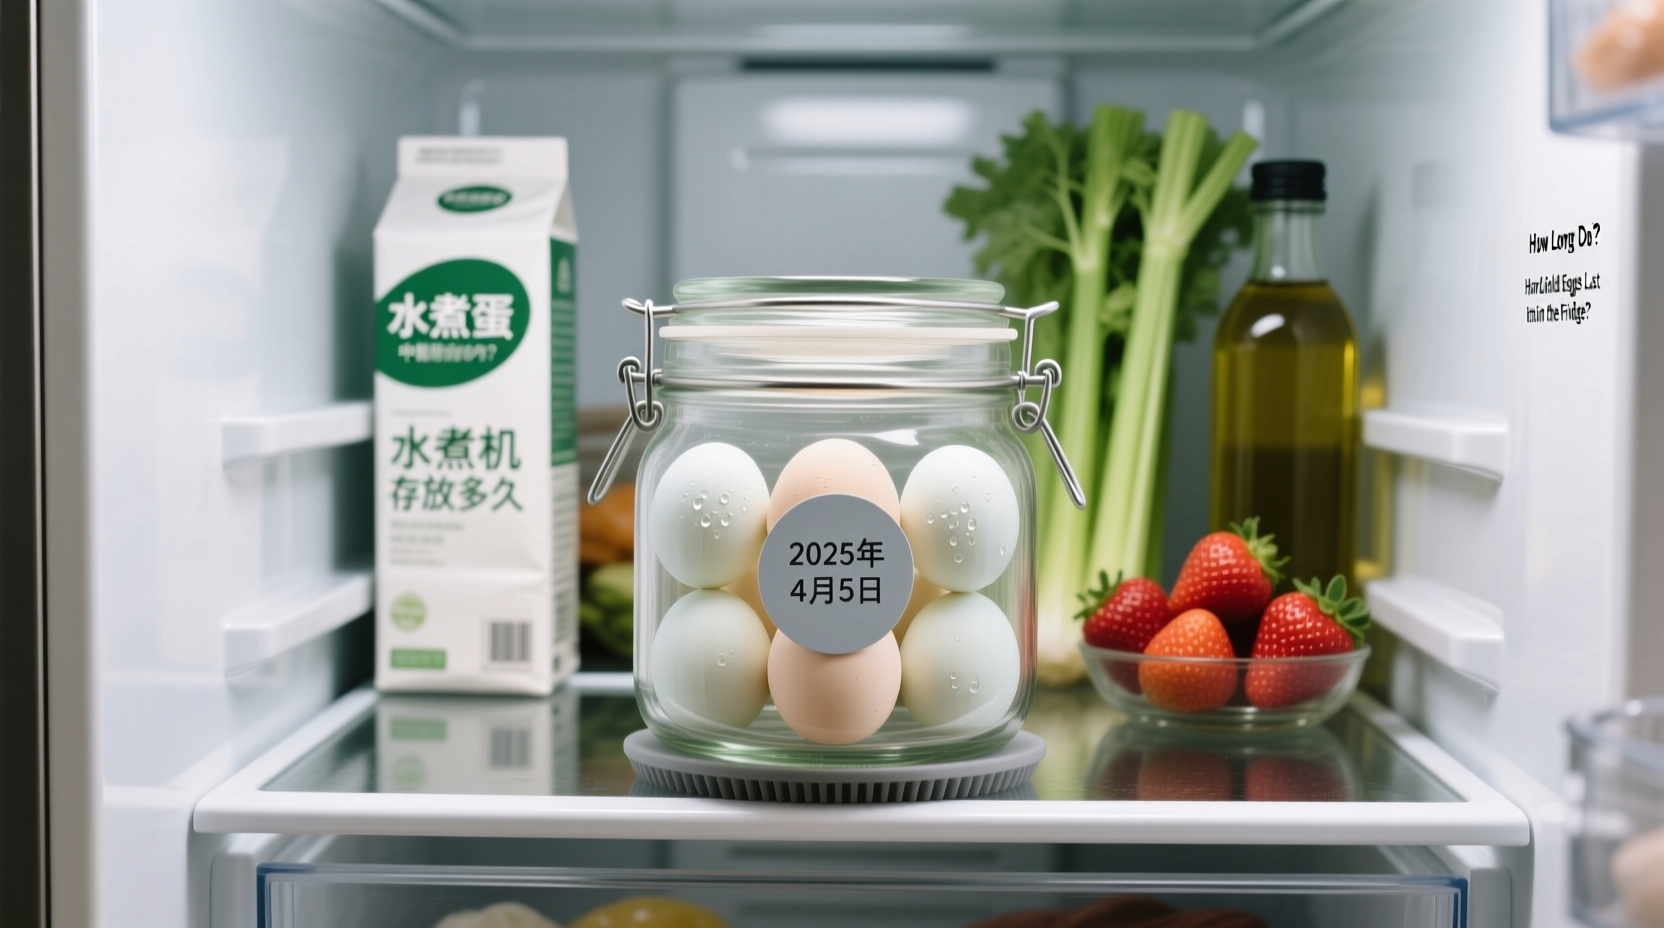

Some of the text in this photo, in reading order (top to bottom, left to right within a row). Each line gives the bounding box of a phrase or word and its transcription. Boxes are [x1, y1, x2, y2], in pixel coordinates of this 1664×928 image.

[387, 291, 515, 340] 水煮蛋
[390, 424, 522, 471] 水煮机
[390, 474, 524, 513] 存放多久
[789, 537, 885, 569] 2025年
[790, 576, 881, 606] 4月5日
